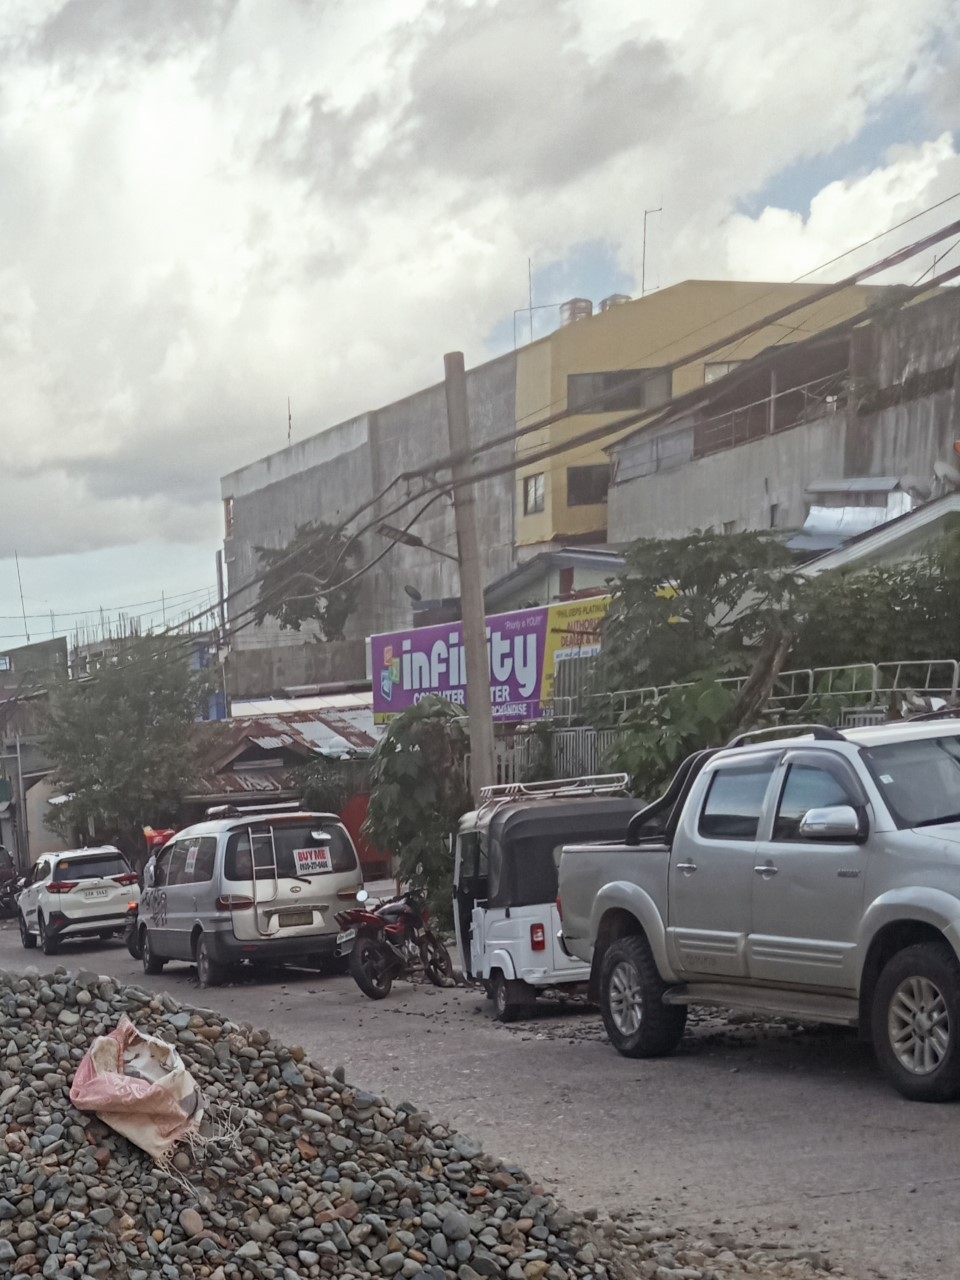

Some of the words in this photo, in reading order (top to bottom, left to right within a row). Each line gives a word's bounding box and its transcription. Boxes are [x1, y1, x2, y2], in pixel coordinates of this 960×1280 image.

[402, 627, 537, 698] infity
[413, 689, 464, 706] COTER
[298, 850, 313, 862] BUY
[314, 849, 326, 860] ME
